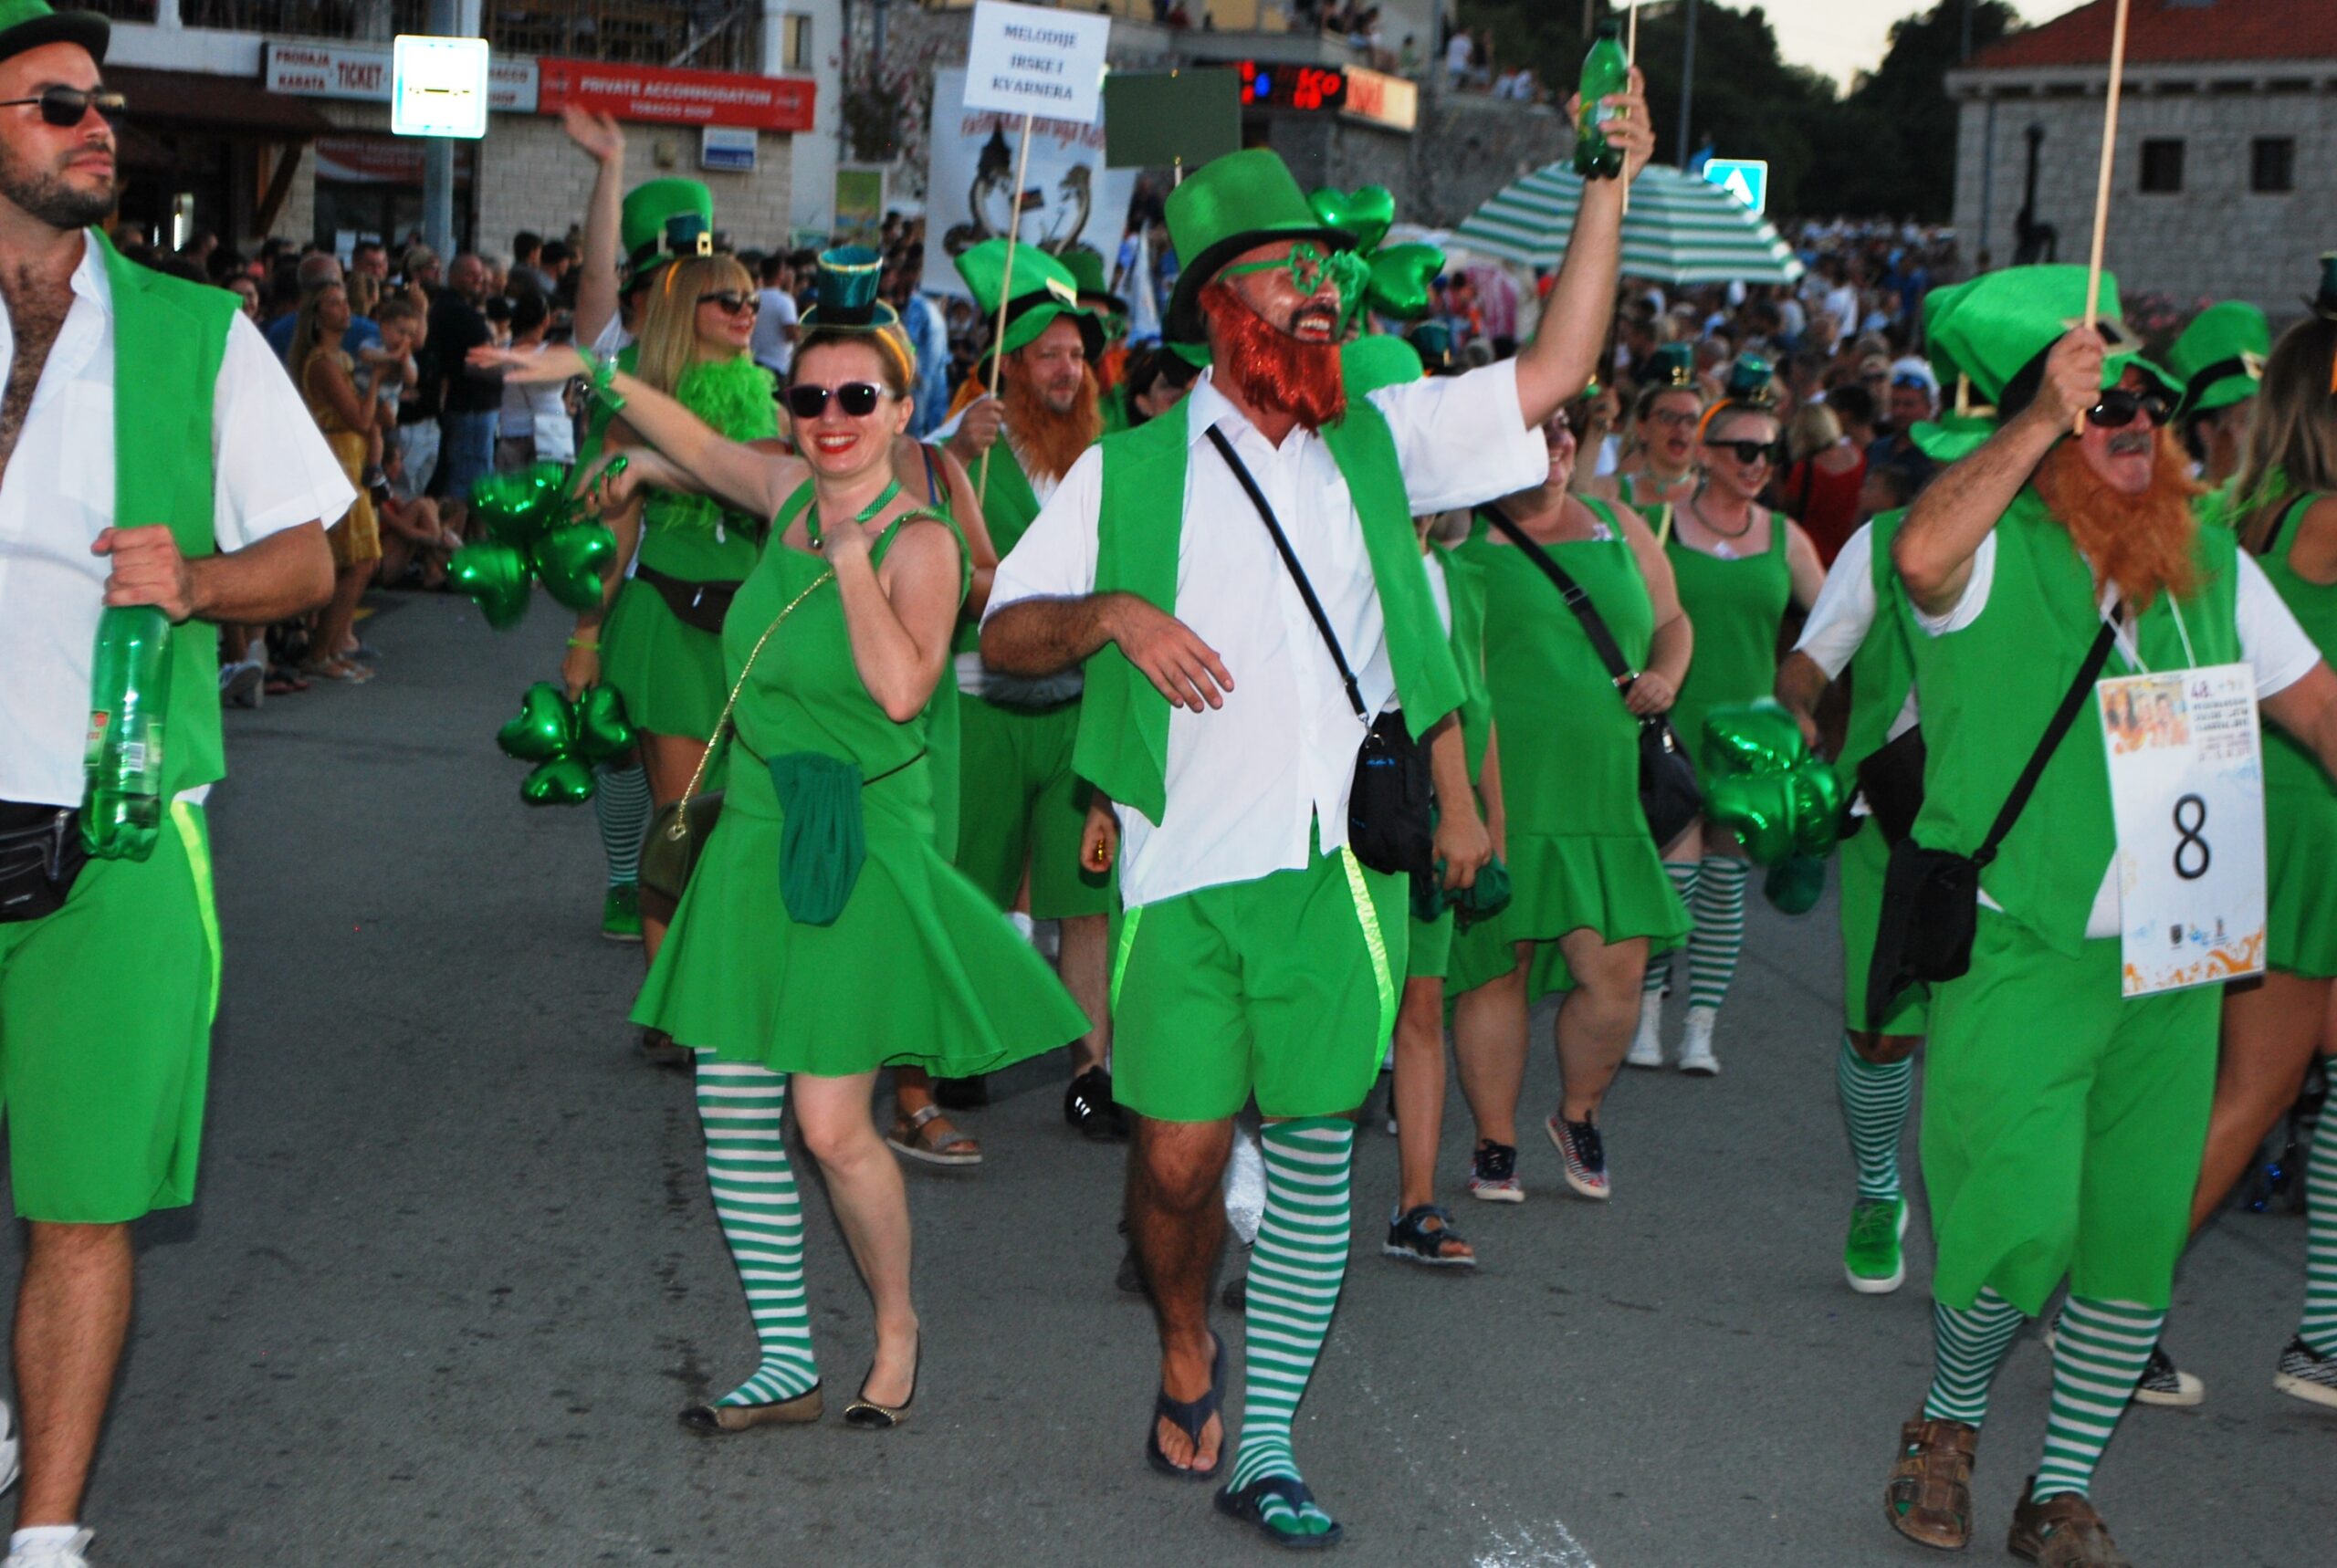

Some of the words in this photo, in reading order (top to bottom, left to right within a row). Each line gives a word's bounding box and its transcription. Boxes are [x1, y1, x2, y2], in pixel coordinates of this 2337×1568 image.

[1003, 25, 1078, 48] MELODIJE
[338, 59, 383, 92] TICKET
[1011, 53, 1053, 74] IRSKE
[1055, 60, 1064, 76] I
[580, 76, 641, 96] PRIVATE
[644, 80, 772, 107] ACCOMMODATION
[991, 76, 1074, 101] KVARNERA
[630, 99, 682, 117] TOBACCO
[2173, 791, 2211, 881] 8
